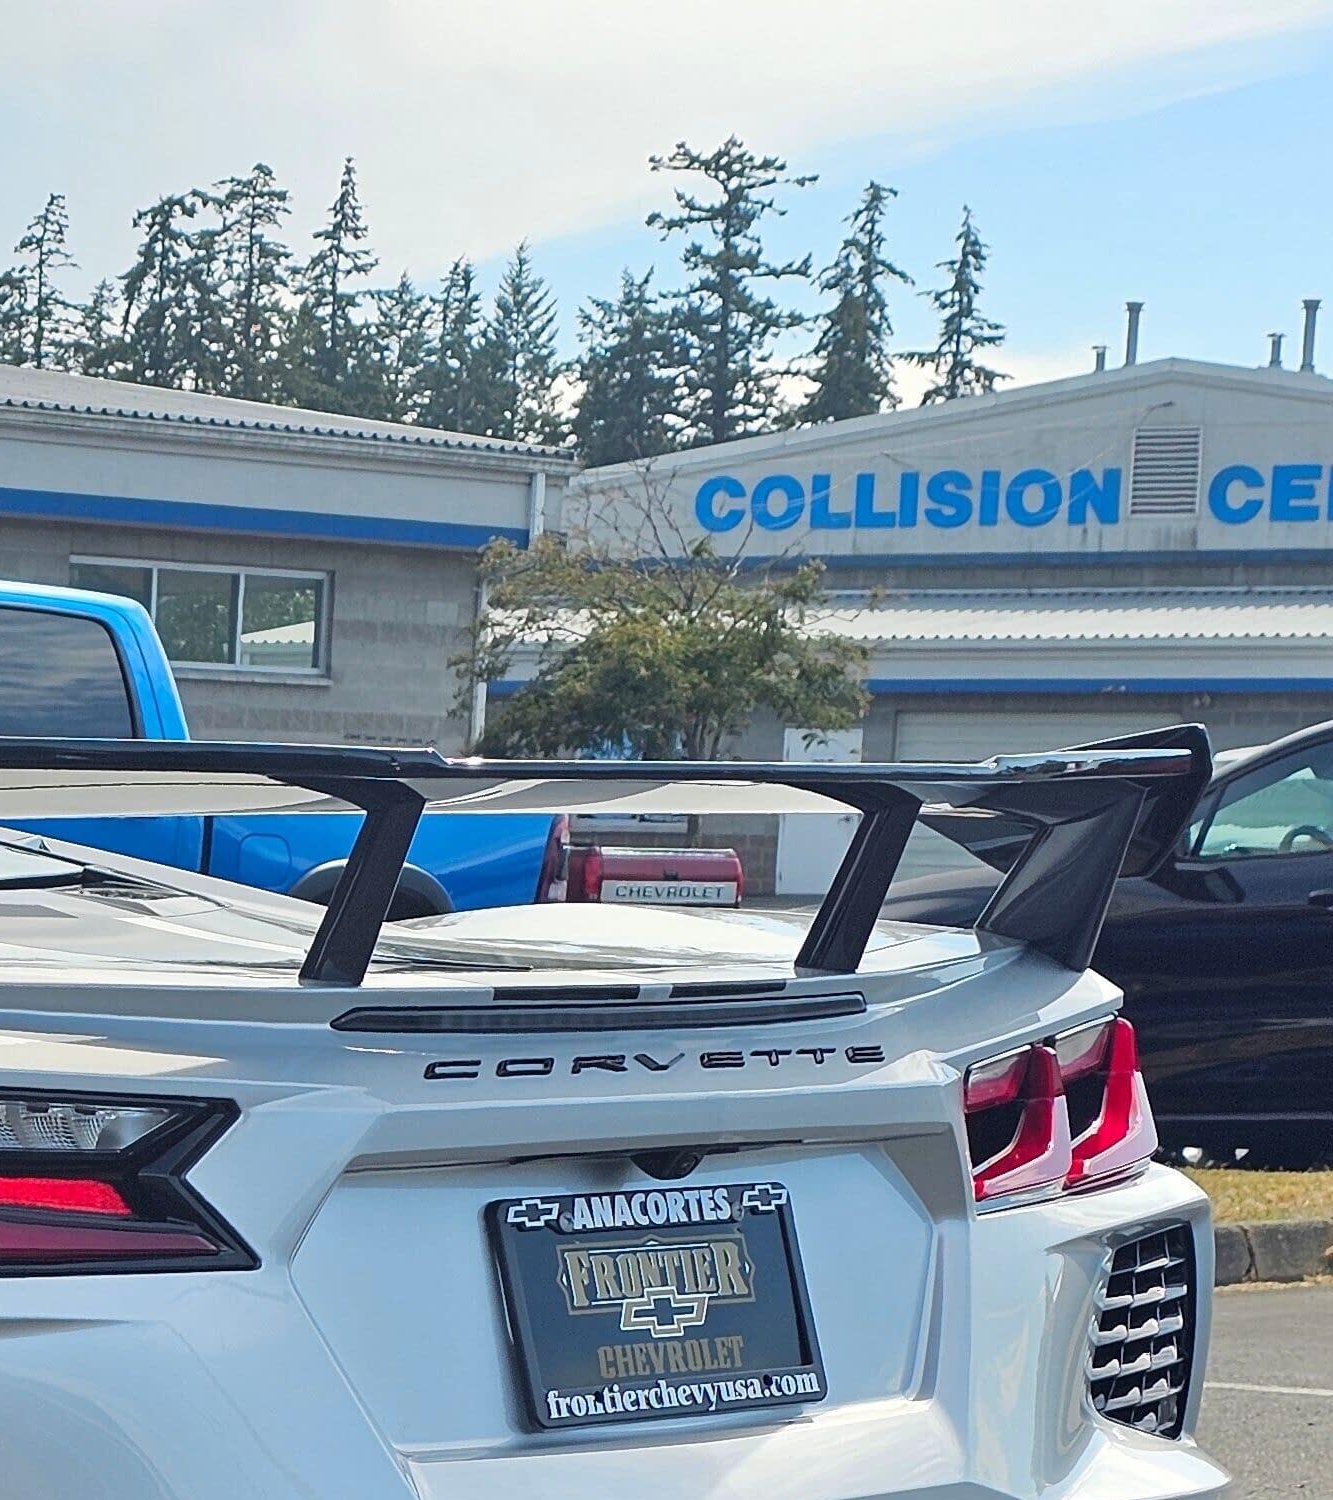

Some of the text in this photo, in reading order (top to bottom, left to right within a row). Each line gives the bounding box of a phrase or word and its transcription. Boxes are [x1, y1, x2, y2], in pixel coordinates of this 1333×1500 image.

[694, 463, 1333, 533] COLLISION CE
[614, 884, 725, 900] CHEVROLET
[422, 1044, 886, 1080] CORVETTE
[573, 1187, 732, 1230] ANACORTES
[564, 1241, 749, 1307] FRONTIER
[596, 1335, 746, 1380] CHEVROLET
[546, 1371, 821, 1419] frontierchevyusa.com
